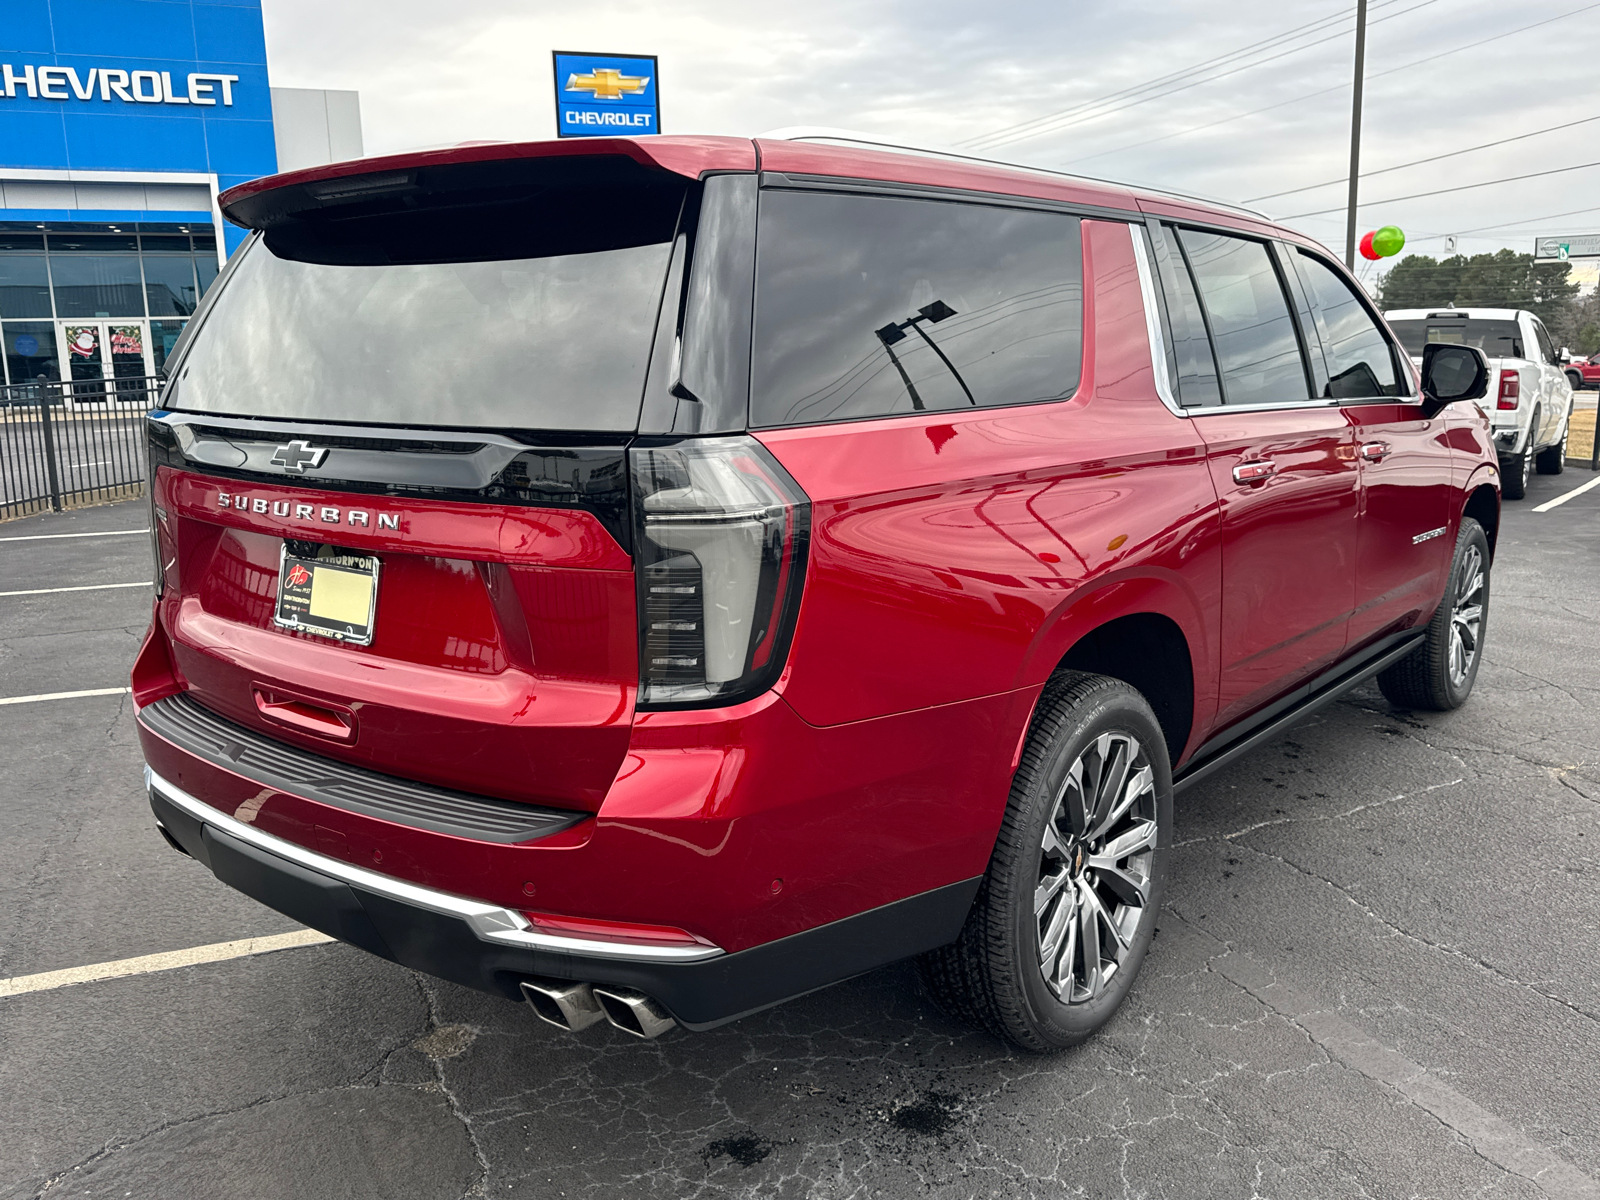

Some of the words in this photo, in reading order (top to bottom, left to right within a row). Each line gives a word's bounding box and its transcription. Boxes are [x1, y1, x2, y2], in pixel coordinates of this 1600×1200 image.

[0, 64, 238, 106] HEVROLET
[565, 110, 652, 127] CHEVROLET
[217, 491, 401, 531] SUBURBAN
[305, 626, 335, 638] CHEVROLET
